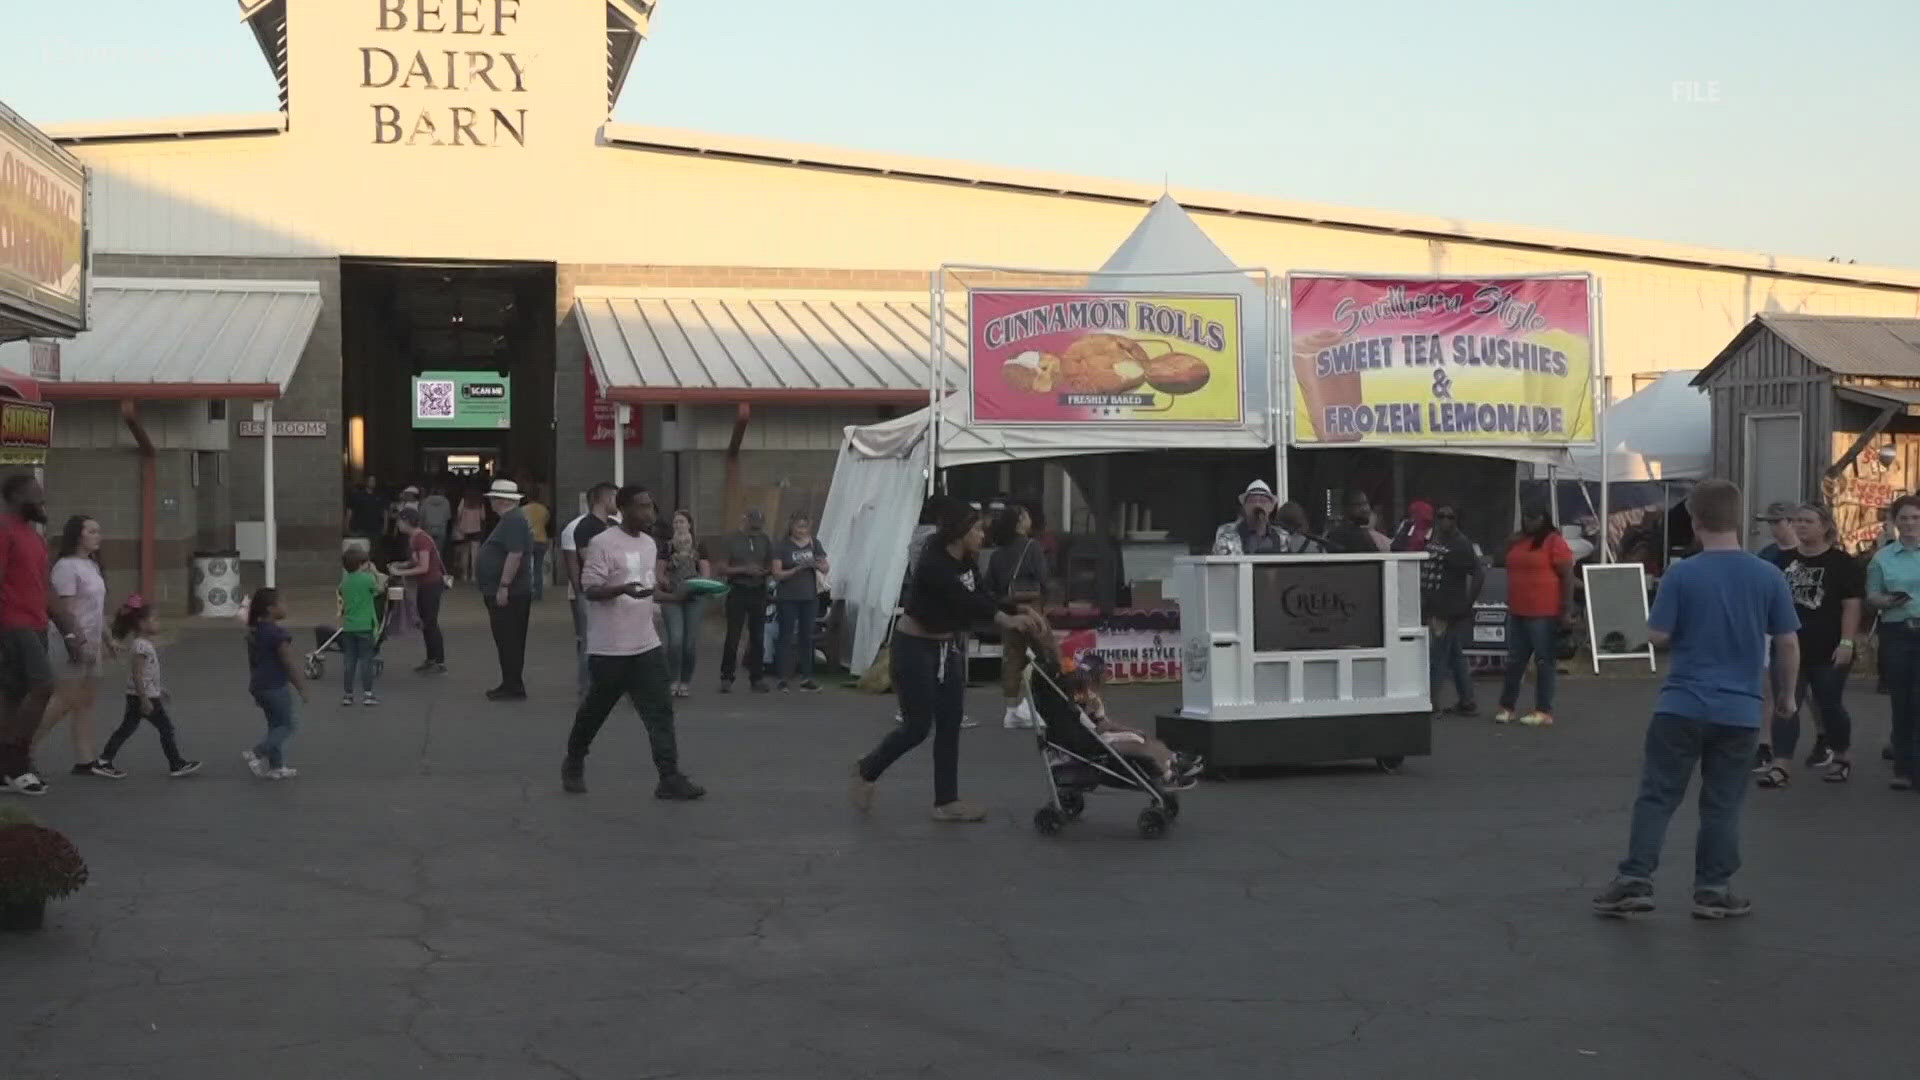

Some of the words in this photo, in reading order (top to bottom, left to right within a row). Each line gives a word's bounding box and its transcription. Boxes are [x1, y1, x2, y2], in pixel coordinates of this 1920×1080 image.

[375, 0, 521, 36] BEEF
[358, 47, 528, 92] DAIRY
[370, 103, 529, 148] BARN
[983, 302, 1130, 349] CINNAMON
[1137, 301, 1225, 351] ROLLS
[1333, 285, 1463, 335] Southern
[1471, 286, 1545, 332] Style
[1315, 336, 1394, 376] SWEET
[1402, 334, 1445, 369] TEA
[1452, 334, 1568, 377] SLUSHIES
[1067, 394, 1108, 406] FRESHLY
[1111, 395, 1142, 406] BAKED
[1431, 368, 1454, 400] &
[241, 422, 326, 435] RESROOMS
[1324, 403, 1422, 434] FROZEN
[1429, 402, 1564, 435] LEMONADE
[1142, 647, 1175, 659] STYLE
